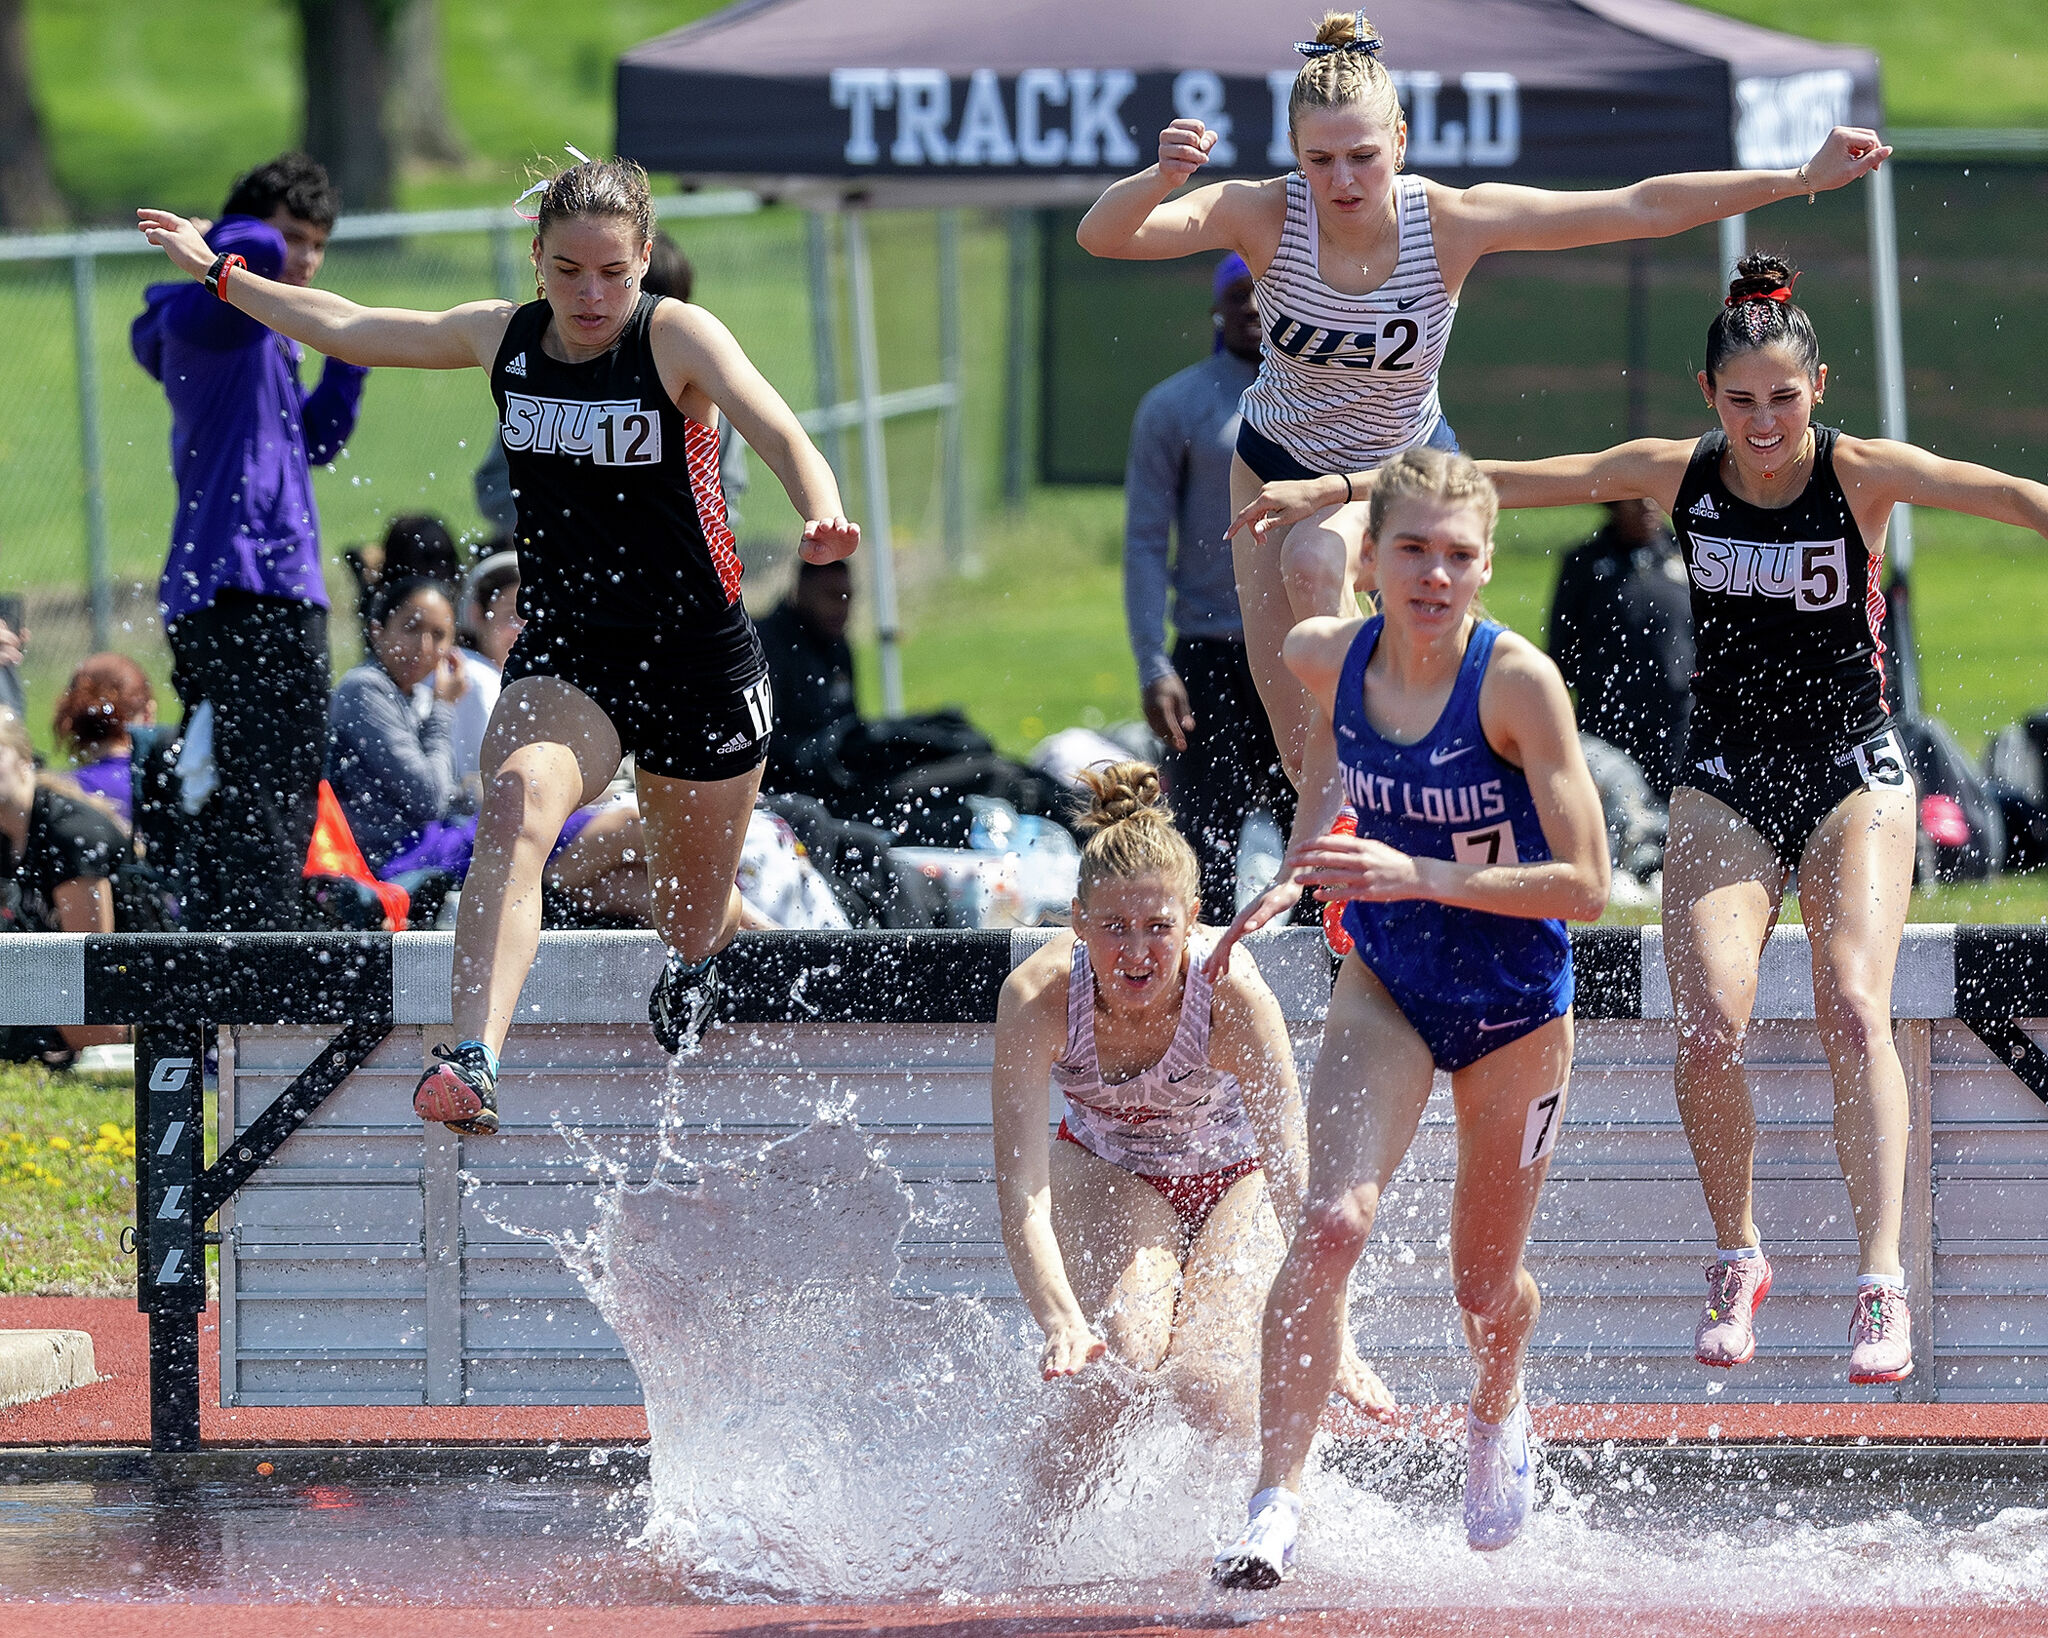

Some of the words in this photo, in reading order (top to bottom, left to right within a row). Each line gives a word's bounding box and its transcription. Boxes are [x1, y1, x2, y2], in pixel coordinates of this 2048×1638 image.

[830, 68, 1142, 167] TRACK
[1378, 318, 1419, 371] 2
[502, 391, 641, 456] SIU
[597, 413, 652, 464] 12
[1688, 506, 1720, 520] adidas
[1801, 545, 1839, 606] 5
[716, 740, 753, 755] adidas
[1862, 737, 1905, 786] 5
[1403, 779, 1506, 825] LOUIS
[1531, 1091, 1560, 1161] 7
[148, 1057, 194, 1284] GILL
